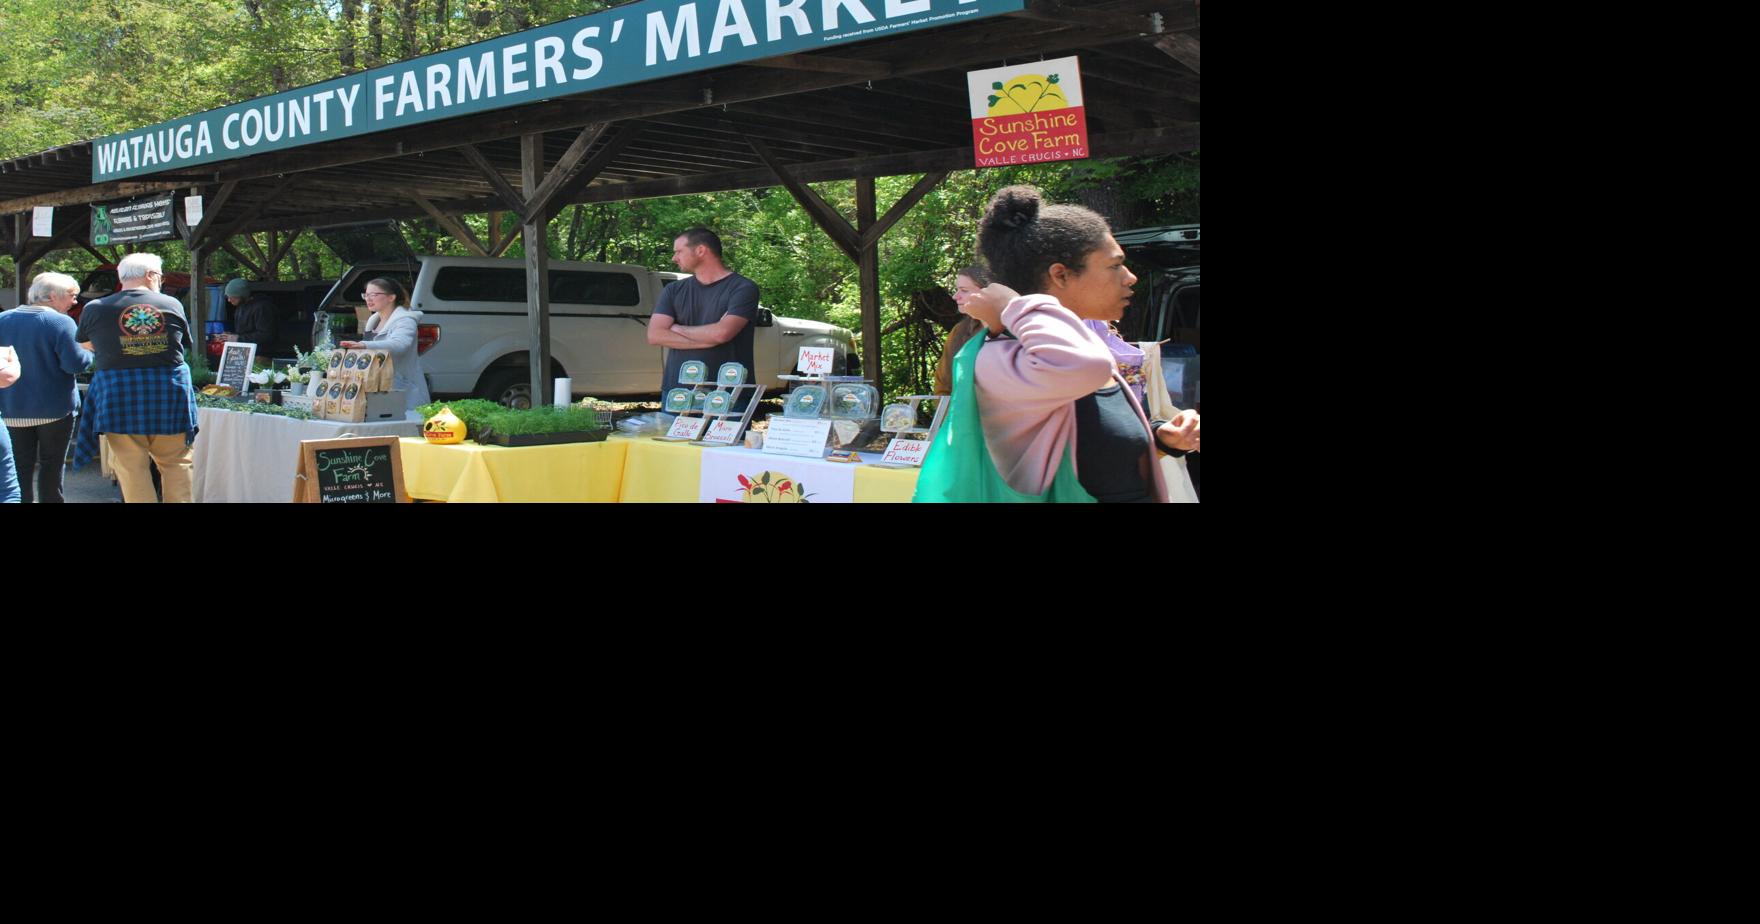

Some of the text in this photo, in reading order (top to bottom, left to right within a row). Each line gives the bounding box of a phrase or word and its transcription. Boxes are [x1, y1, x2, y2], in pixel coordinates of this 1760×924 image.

[824, 33, 842, 42] Funding
[843, 30, 862, 38] received
[911, 17, 929, 25] Market
[929, 12, 956, 22] Promotion
[956, 8, 979, 17] Program
[98, 120, 213, 175] WATAUGA
[222, 84, 361, 150] COUNTY
[375, 19, 624, 120] FARMERS'
[980, 113, 1077, 136] Sunshine
[980, 131, 1080, 155] Cove Farm
[979, 148, 1085, 166] VALLE CRUCIS NC
[801, 350, 829, 361] Market
[807, 360, 822, 372] Mix
[675, 418, 699, 430] Pico de
[893, 440, 921, 452] Edible
[317, 449, 387, 471] Sunshine Cove
[884, 450, 919, 463] Flowers
[333, 467, 360, 484] Farm
[322, 493, 363, 503] Microgreens
[373, 490, 391, 501] More
